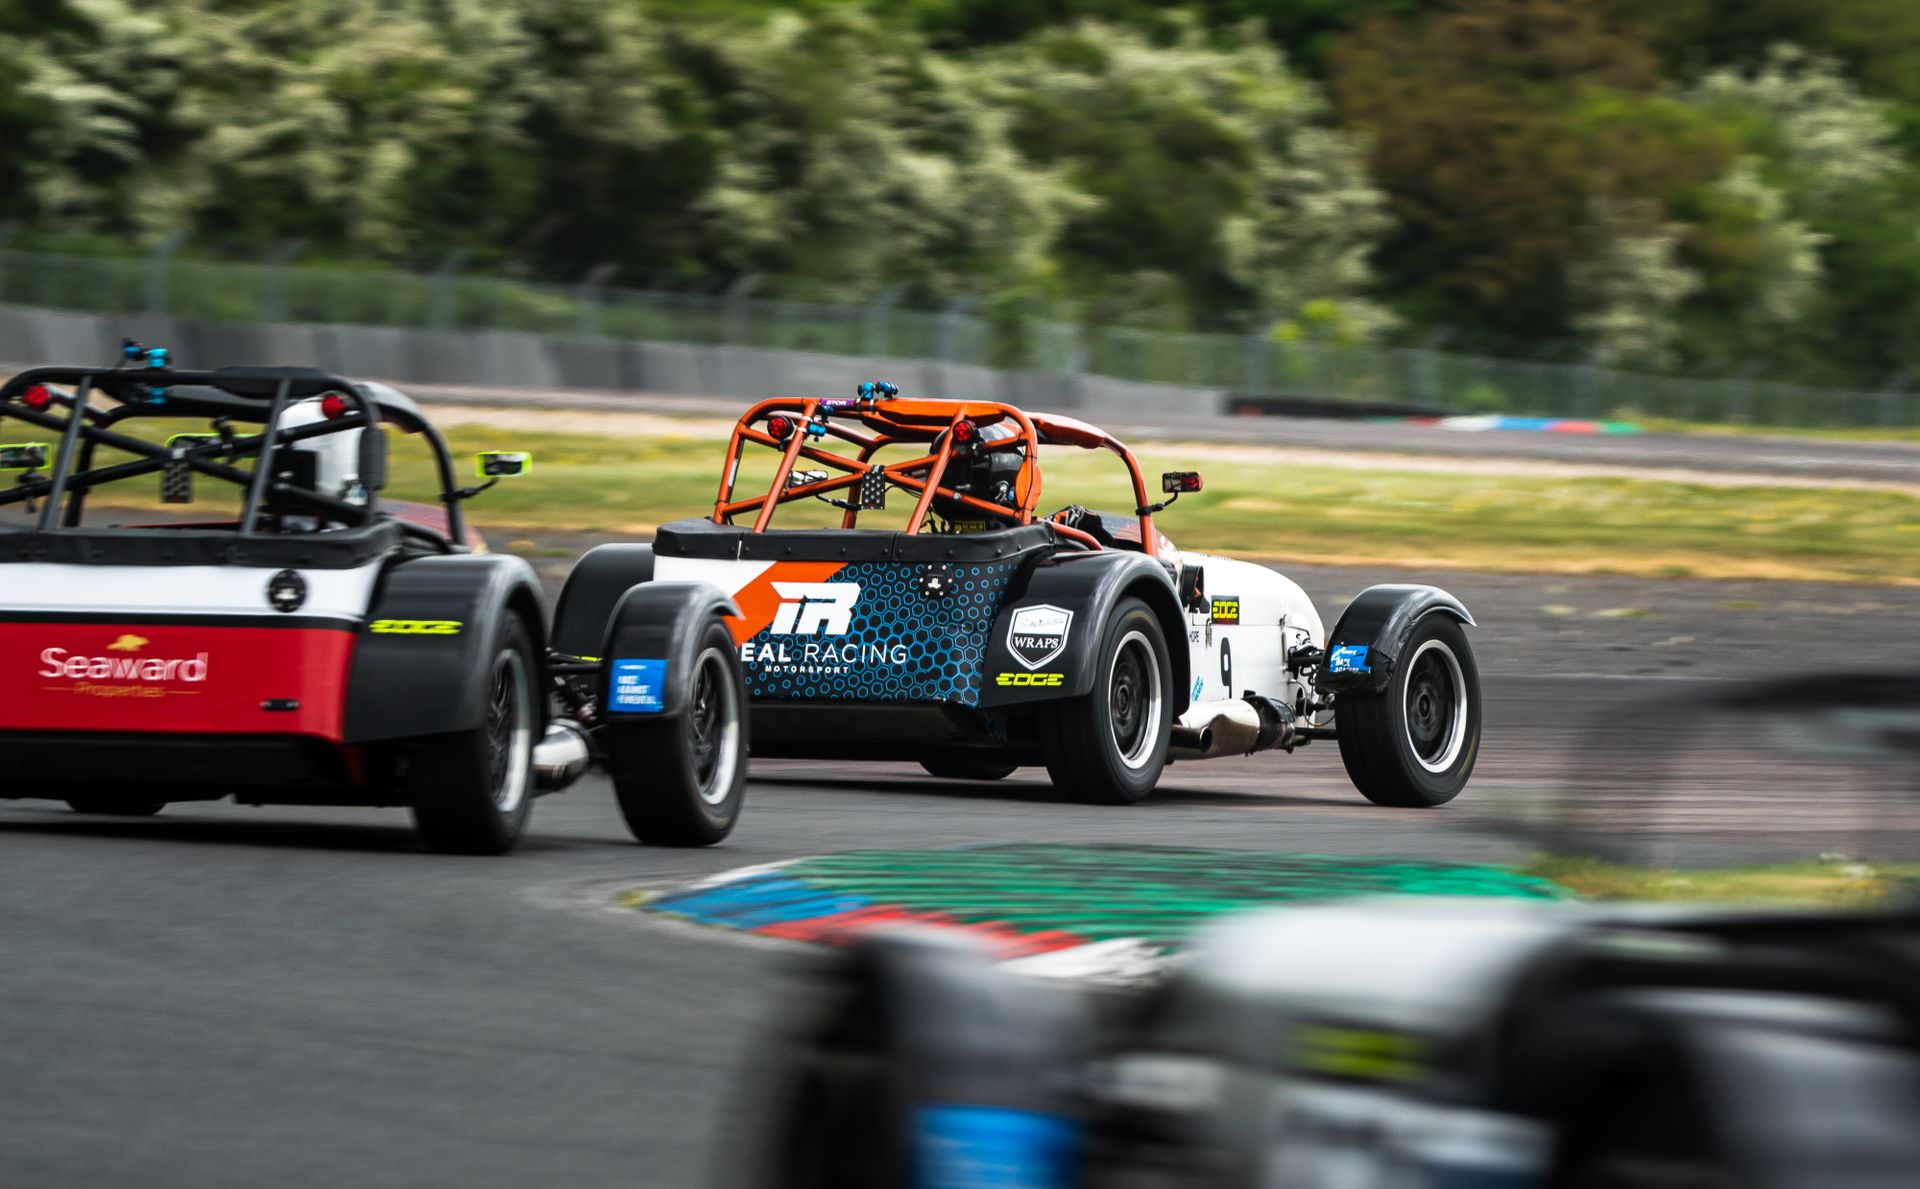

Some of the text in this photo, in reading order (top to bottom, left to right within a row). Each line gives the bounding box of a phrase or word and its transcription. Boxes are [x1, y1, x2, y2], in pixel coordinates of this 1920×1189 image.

[368, 619, 464, 635] EDGE
[1014, 636, 1060, 649] WRAPS
[736, 643, 908, 665] EAL RACING
[38, 647, 209, 683] Seaward
[764, 665, 850, 675] MOTORSPORT
[1220, 637, 1233, 700] 9
[995, 672, 1065, 687] EDGE
[73, 681, 167, 699] Properties
